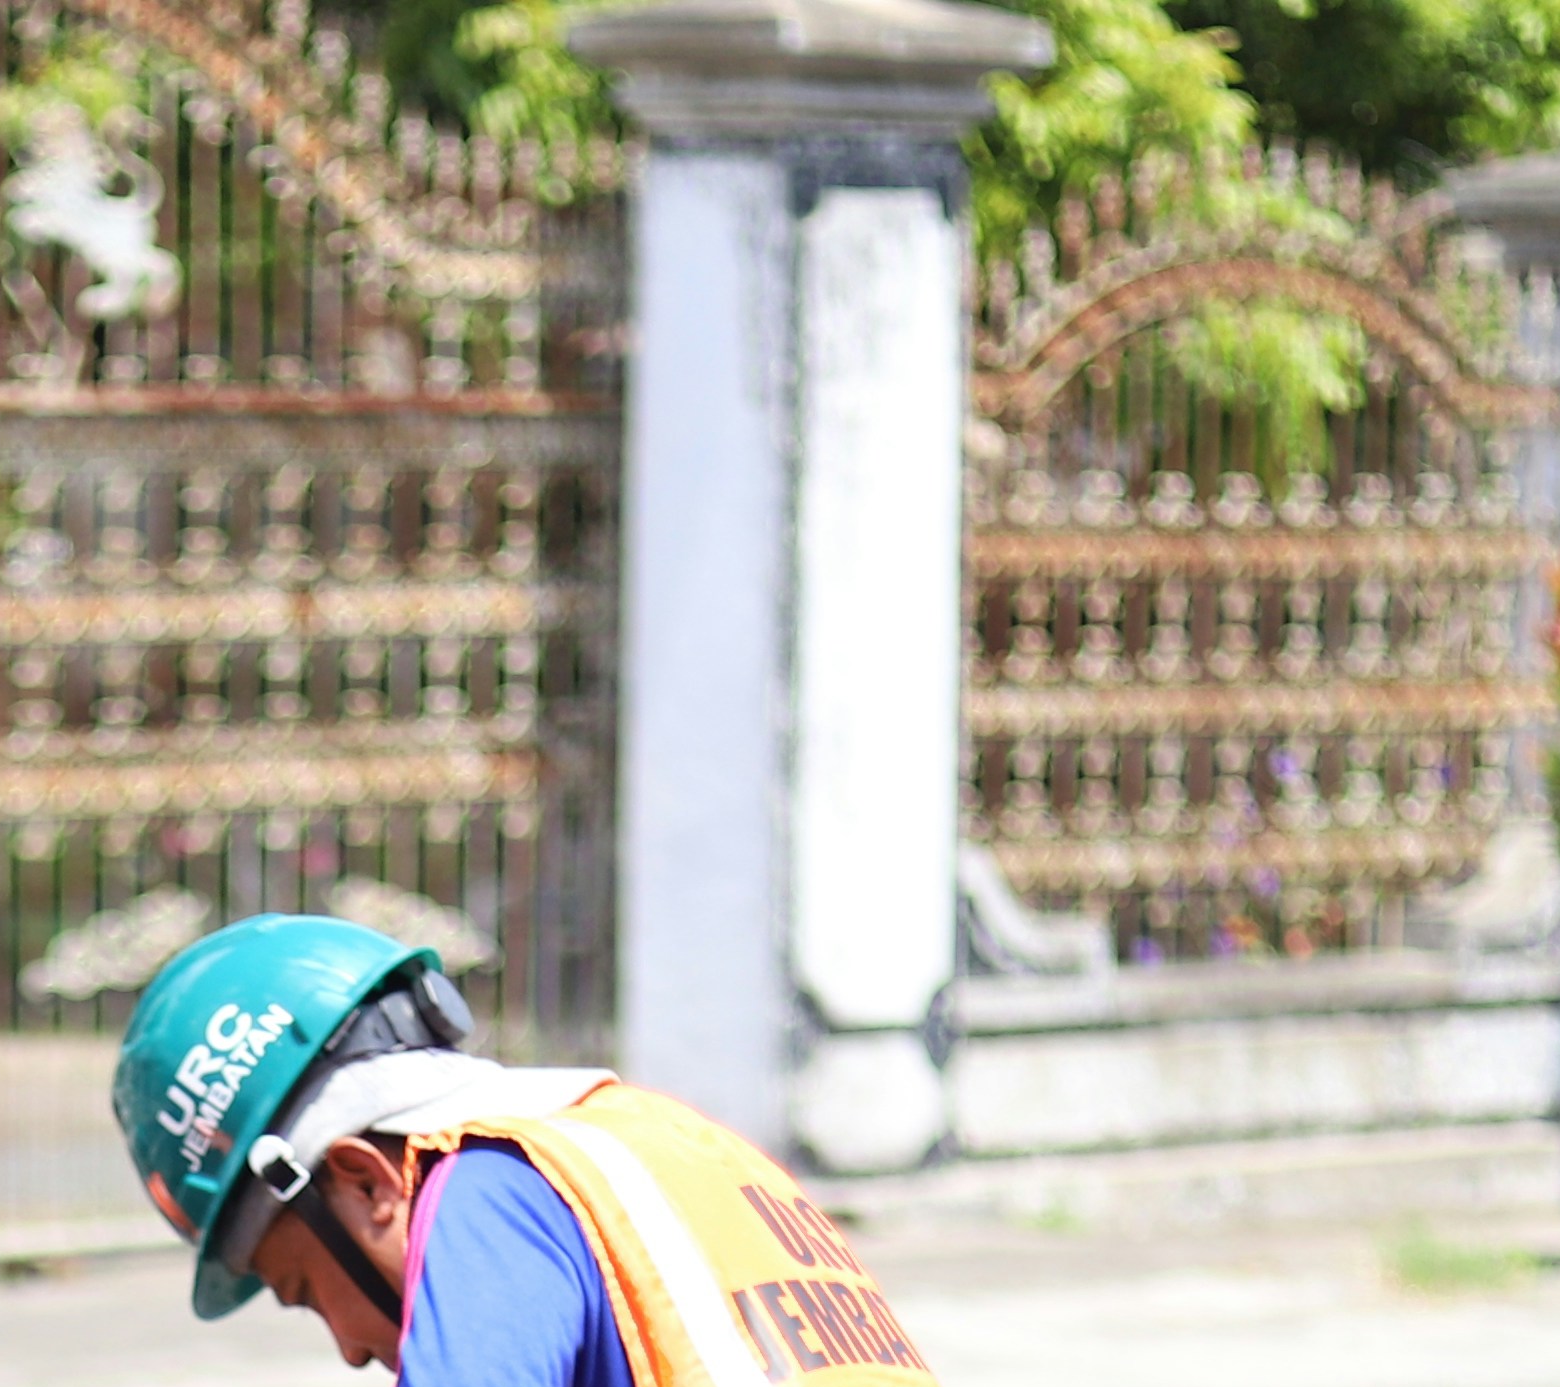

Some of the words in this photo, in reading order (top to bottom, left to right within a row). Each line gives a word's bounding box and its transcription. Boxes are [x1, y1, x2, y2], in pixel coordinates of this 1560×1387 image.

[156, 1003, 253, 1136] URC
[179, 1003, 295, 1172] JEMBATAN
[739, 1184, 863, 1276] URC
[731, 1278, 931, 1385] JEMBA
